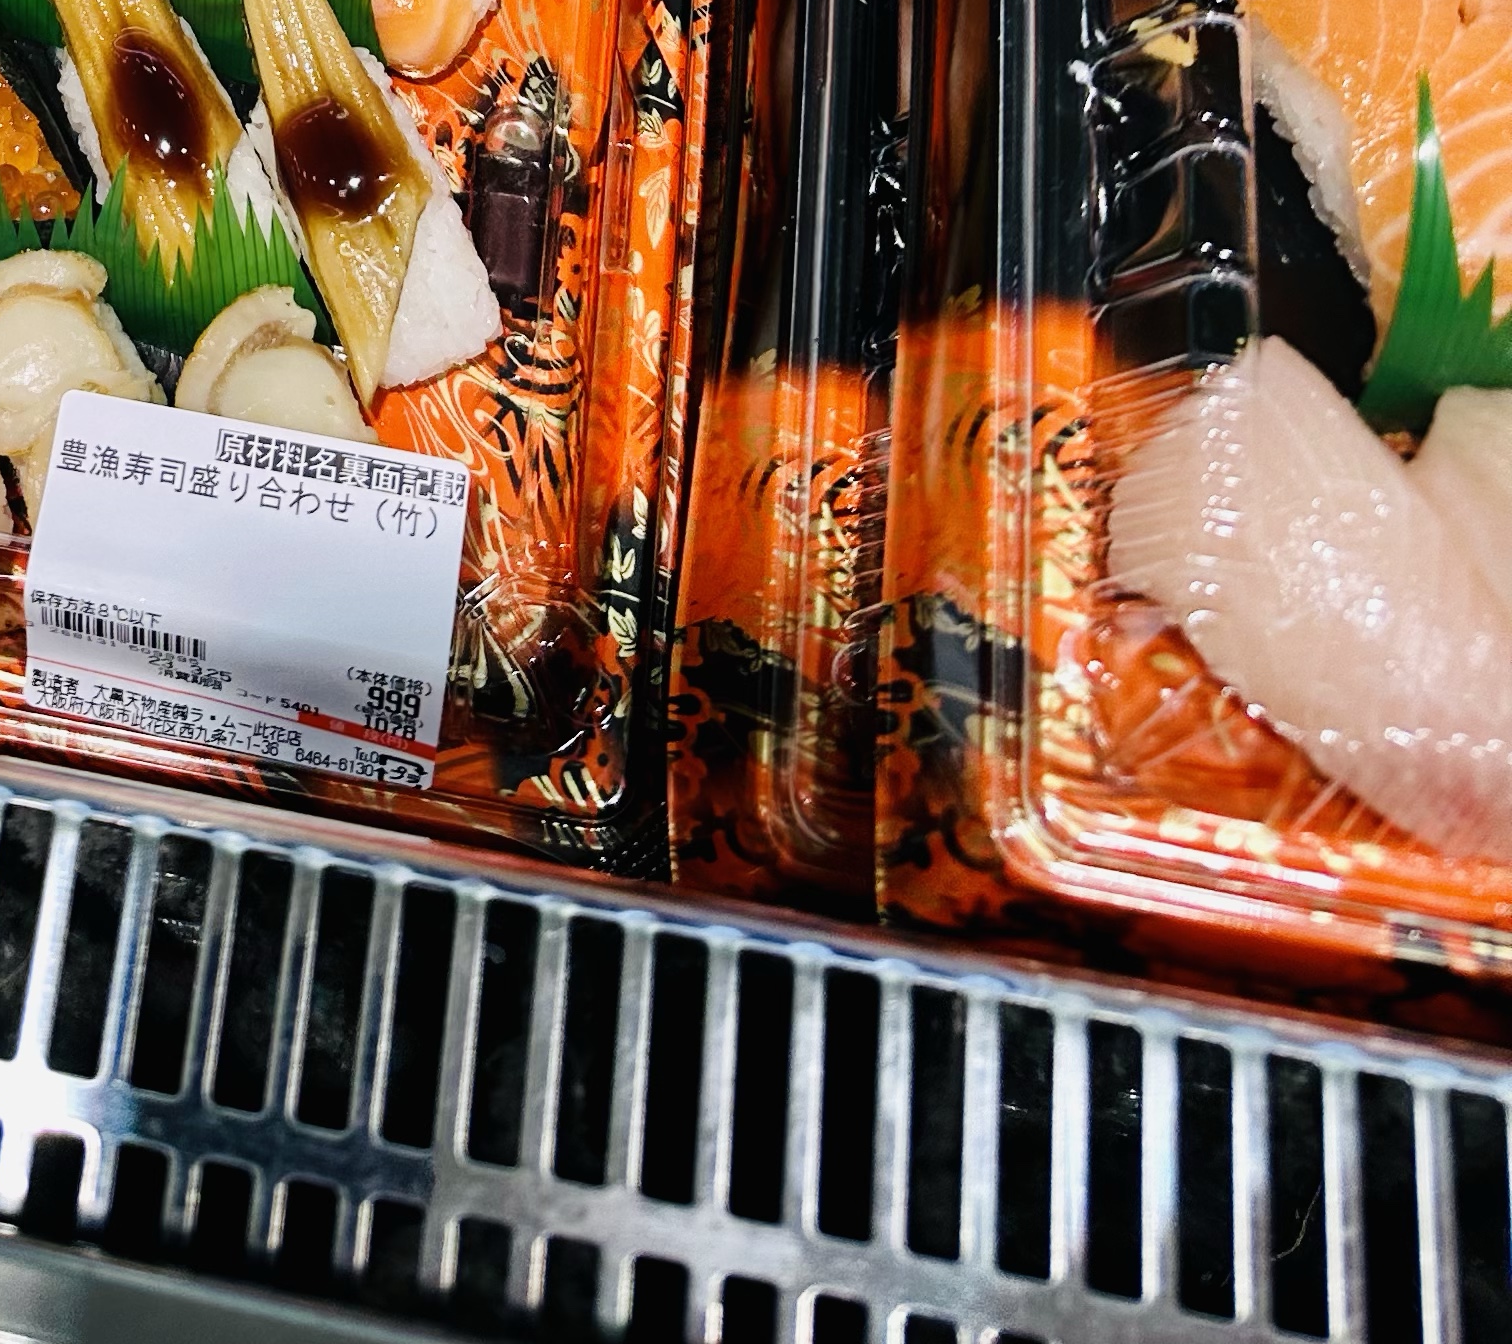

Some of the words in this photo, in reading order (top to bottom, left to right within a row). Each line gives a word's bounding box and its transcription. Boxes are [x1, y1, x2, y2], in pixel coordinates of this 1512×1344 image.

[216, 429, 467, 507] 原材料名裏面記載
[33, 669, 79, 696] 製造者
[367, 686, 421, 719] 999
[364, 715, 416, 741] 1078
